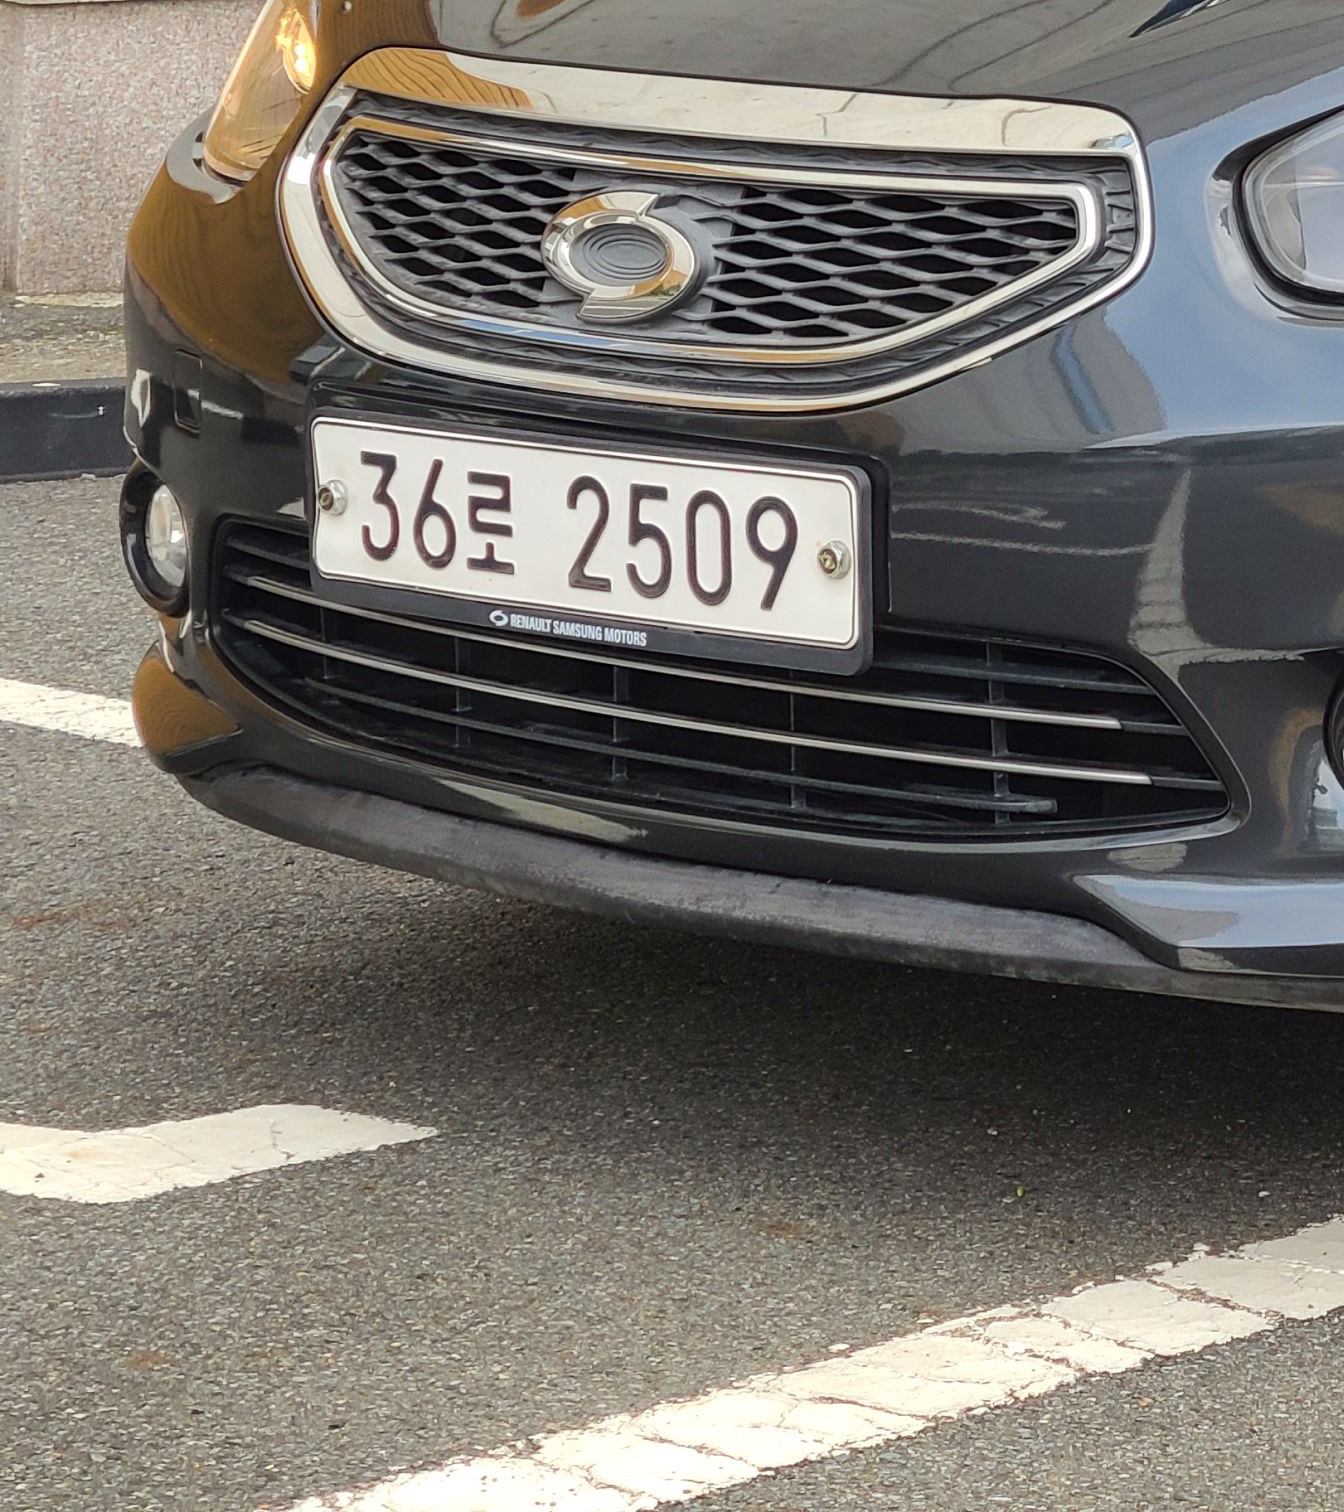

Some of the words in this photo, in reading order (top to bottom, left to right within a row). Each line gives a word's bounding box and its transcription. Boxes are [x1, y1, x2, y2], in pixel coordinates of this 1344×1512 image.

[360, 451, 515, 575] 36로
[567, 474, 798, 610] 2509
[510, 614, 552, 633] RENAULT
[553, 620, 603, 641] SAMSUNG
[604, 628, 647, 647] MOTORS
